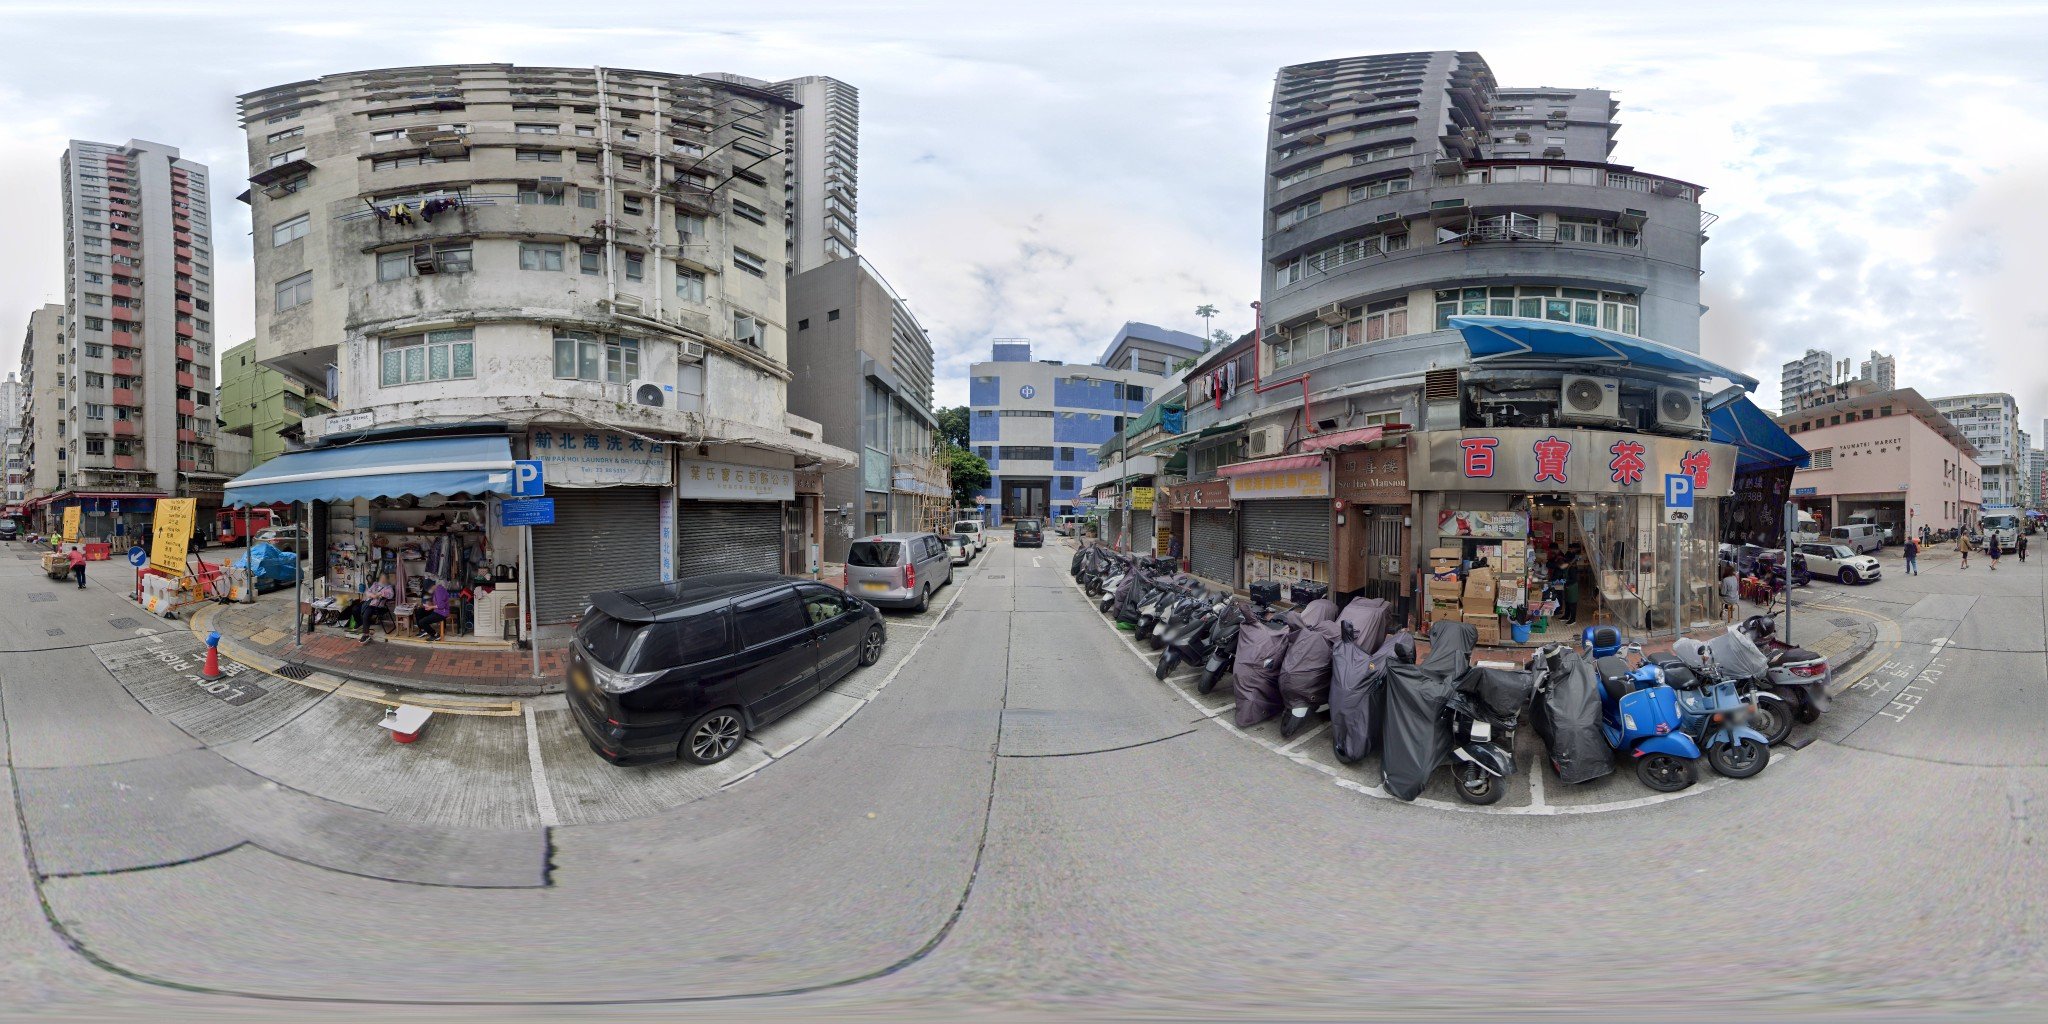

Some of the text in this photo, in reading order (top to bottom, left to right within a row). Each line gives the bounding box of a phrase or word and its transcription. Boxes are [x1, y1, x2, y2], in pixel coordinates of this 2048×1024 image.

[535, 431, 664, 454] 新北海洗衣店
[1874, 438, 1902, 446] MARKET
[1460, 436, 1712, 489] 百寶茶檔
[516, 464, 538, 493] P
[1370, 478, 1406, 487] Mansion
[1670, 478, 1689, 505] P
[1878, 684, 1929, 723] LEFT
